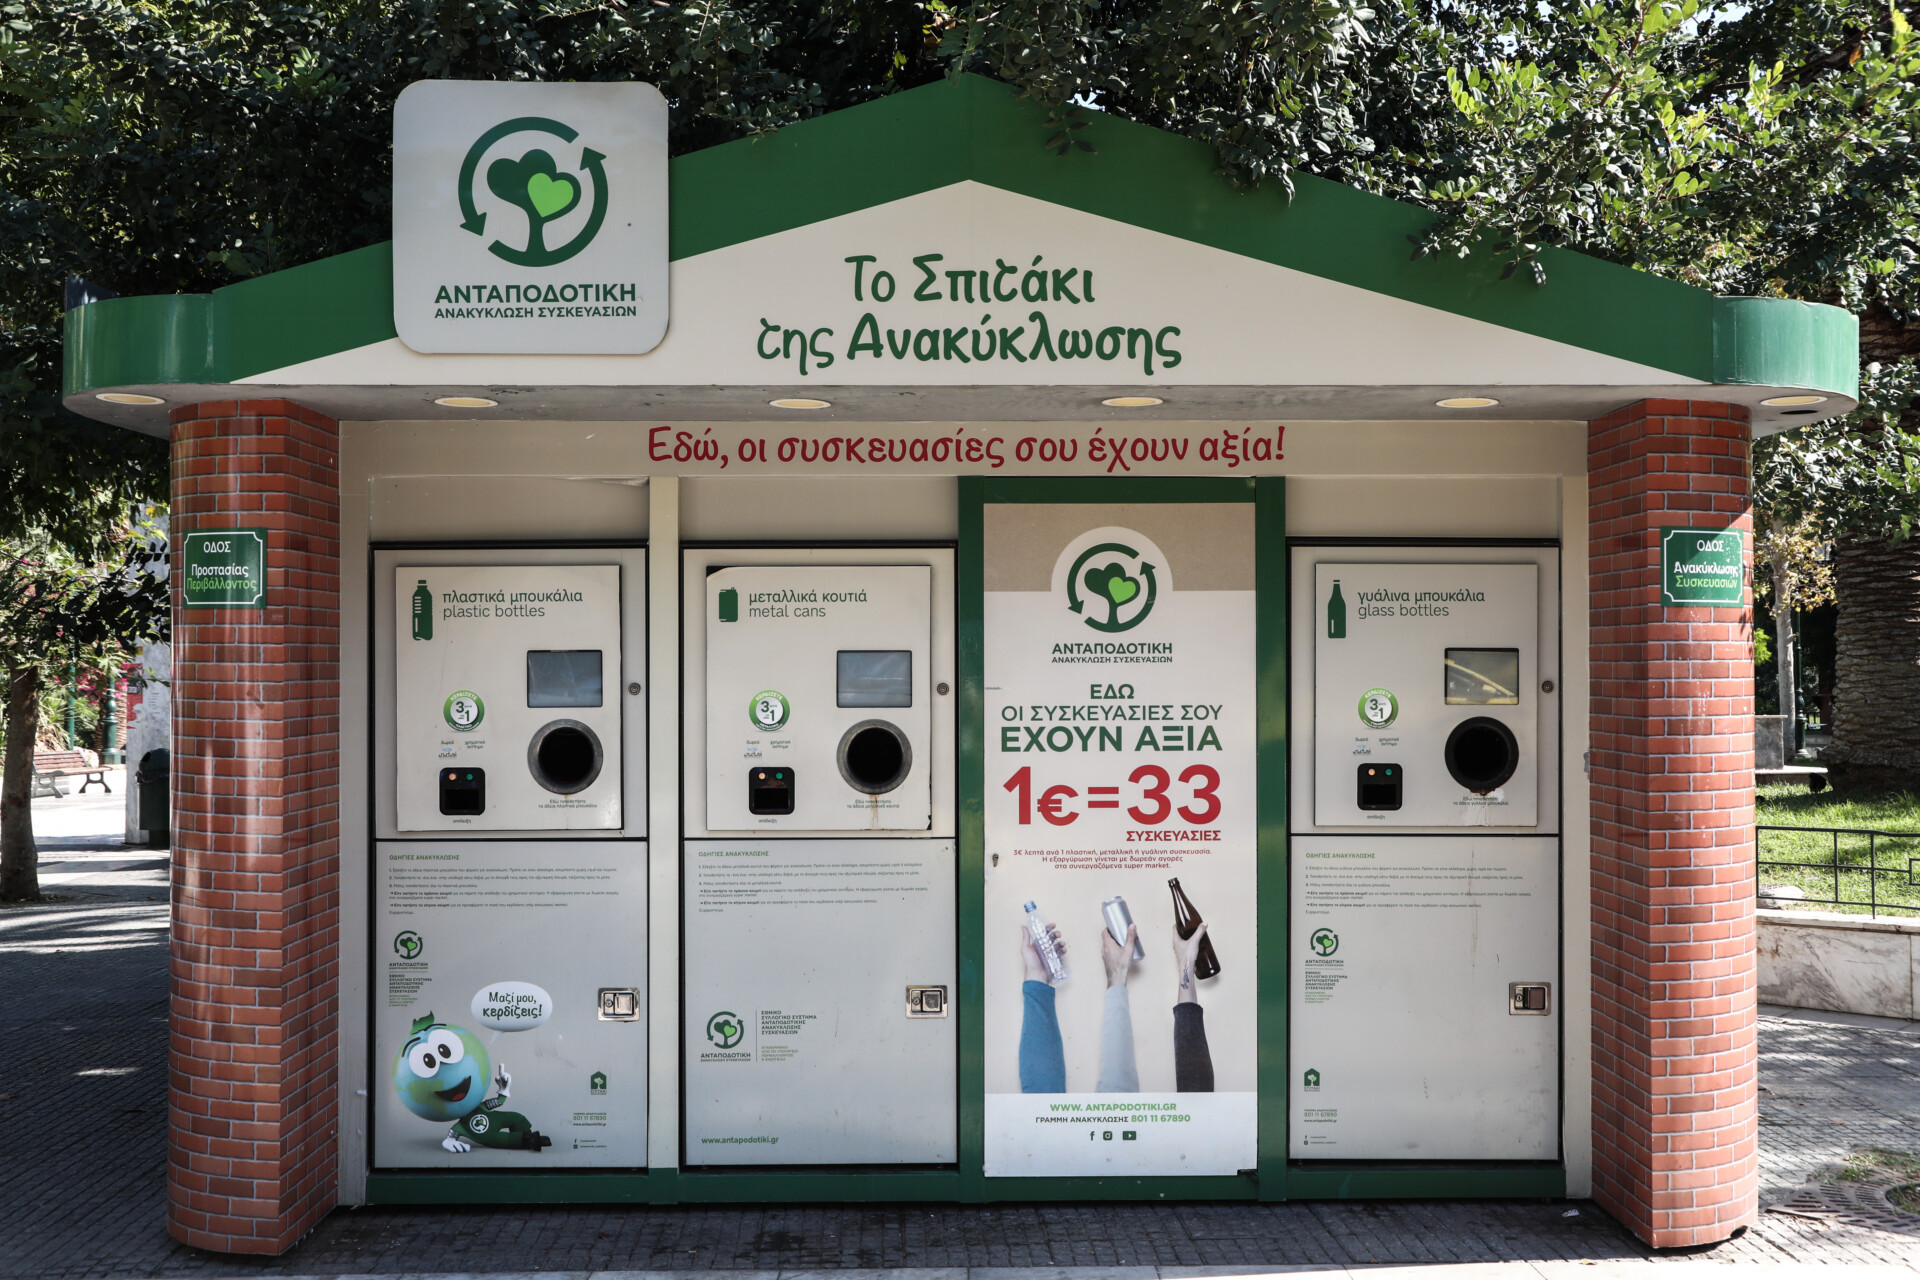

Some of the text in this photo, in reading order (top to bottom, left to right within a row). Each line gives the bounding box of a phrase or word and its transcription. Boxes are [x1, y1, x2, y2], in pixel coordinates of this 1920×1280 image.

[844, 253, 1096, 304] Το Σπιτάκι
[434, 283, 636, 304] ΑΝΤΑΠΟΔΟΤΙΚΗ
[434, 305, 637, 319] ΑΝΑΚΥΚΛΩΣΗ ΣΥΣΚΕΥΑΣΙΩΝ
[757, 311, 1182, 376] της Ανακύκλωσης
[647, 426, 1286, 472] Εδώ, οι συσκευασίες σου έχουν αξία!
[203, 541, 231, 553] ΟΔΟΣ
[1696, 540, 1724, 552] ΟΔΟΣ
[191, 563, 249, 579] Προστασίας
[1673, 561, 1739, 577] Ανακύκλωσης
[186, 577, 257, 592] Περιβάλλοντος
[443, 589, 583, 606] πλαστικά μπουκάλια
[749, 589, 868, 606] μεταλλικά κουτιά
[1358, 588, 1485, 606] γυάλινα μπουκάλια
[443, 603, 546, 621] plastic bottles
[749, 604, 826, 618] metal cans
[1358, 603, 1450, 620] glass bottles
[1052, 643, 1173, 655] ΑΝΤΑΠΟΔΟΤΙΚΗ
[1090, 684, 1135, 699] ΕΔΩ
[455, 701, 465, 713] 3
[761, 701, 770, 713] 3
[1001, 704, 1223, 721] ΟΙ ΣΥΣΚΕΥΑΣΙΕΣ ΣΟΥ
[1369, 699, 1378, 711] 3
[465, 710, 470, 722] 1
[769, 710, 775, 721] 1
[1378, 707, 1384, 719] 1
[1001, 725, 1223, 752] ΕΧΟΥΝ ΑΞΙΑ
[1126, 830, 1222, 842] ΣΥΣΚΕΥΑΣΙΕΣ
[1024, 849, 1044, 857] λεπτά
[1100, 848, 1133, 857] μεταλλική
[1141, 848, 1168, 857] γυάλινη
[1129, 855, 1156, 863] δωρεάν
[1158, 855, 1183, 863] αγορές
[489, 991, 537, 1006] Μαζί μου,
[482, 1004, 543, 1020] κερδίζεις!
[1130, 1115, 1148, 1123] 801
[1150, 1115, 1158, 1123] 11
[1160, 1114, 1191, 1122] 67890
[701, 1136, 779, 1145] www.antapodotiki.gr
